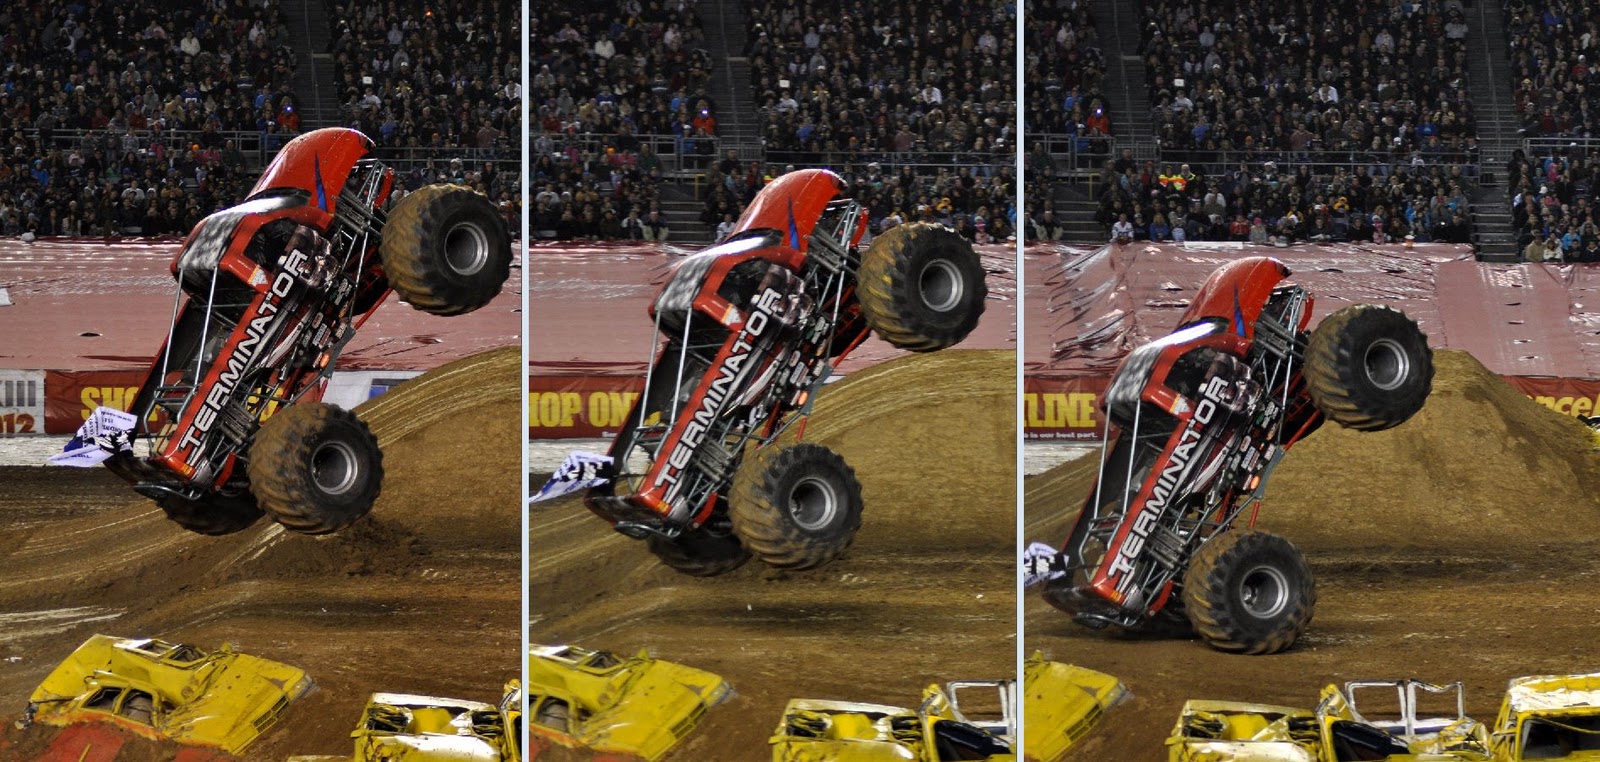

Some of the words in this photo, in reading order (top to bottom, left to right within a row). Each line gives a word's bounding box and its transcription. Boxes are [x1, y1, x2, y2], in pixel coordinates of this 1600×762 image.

[181, 248, 308, 452] TERMINATOR
[0, 381, 36, 407] III
[654, 287, 782, 488] TERMINATOR
[0, 413, 36, 433] 12
[589, 392, 640, 427] ON
[1024, 393, 1097, 427] LINE
[1107, 376, 1229, 578] TERMINATOR
